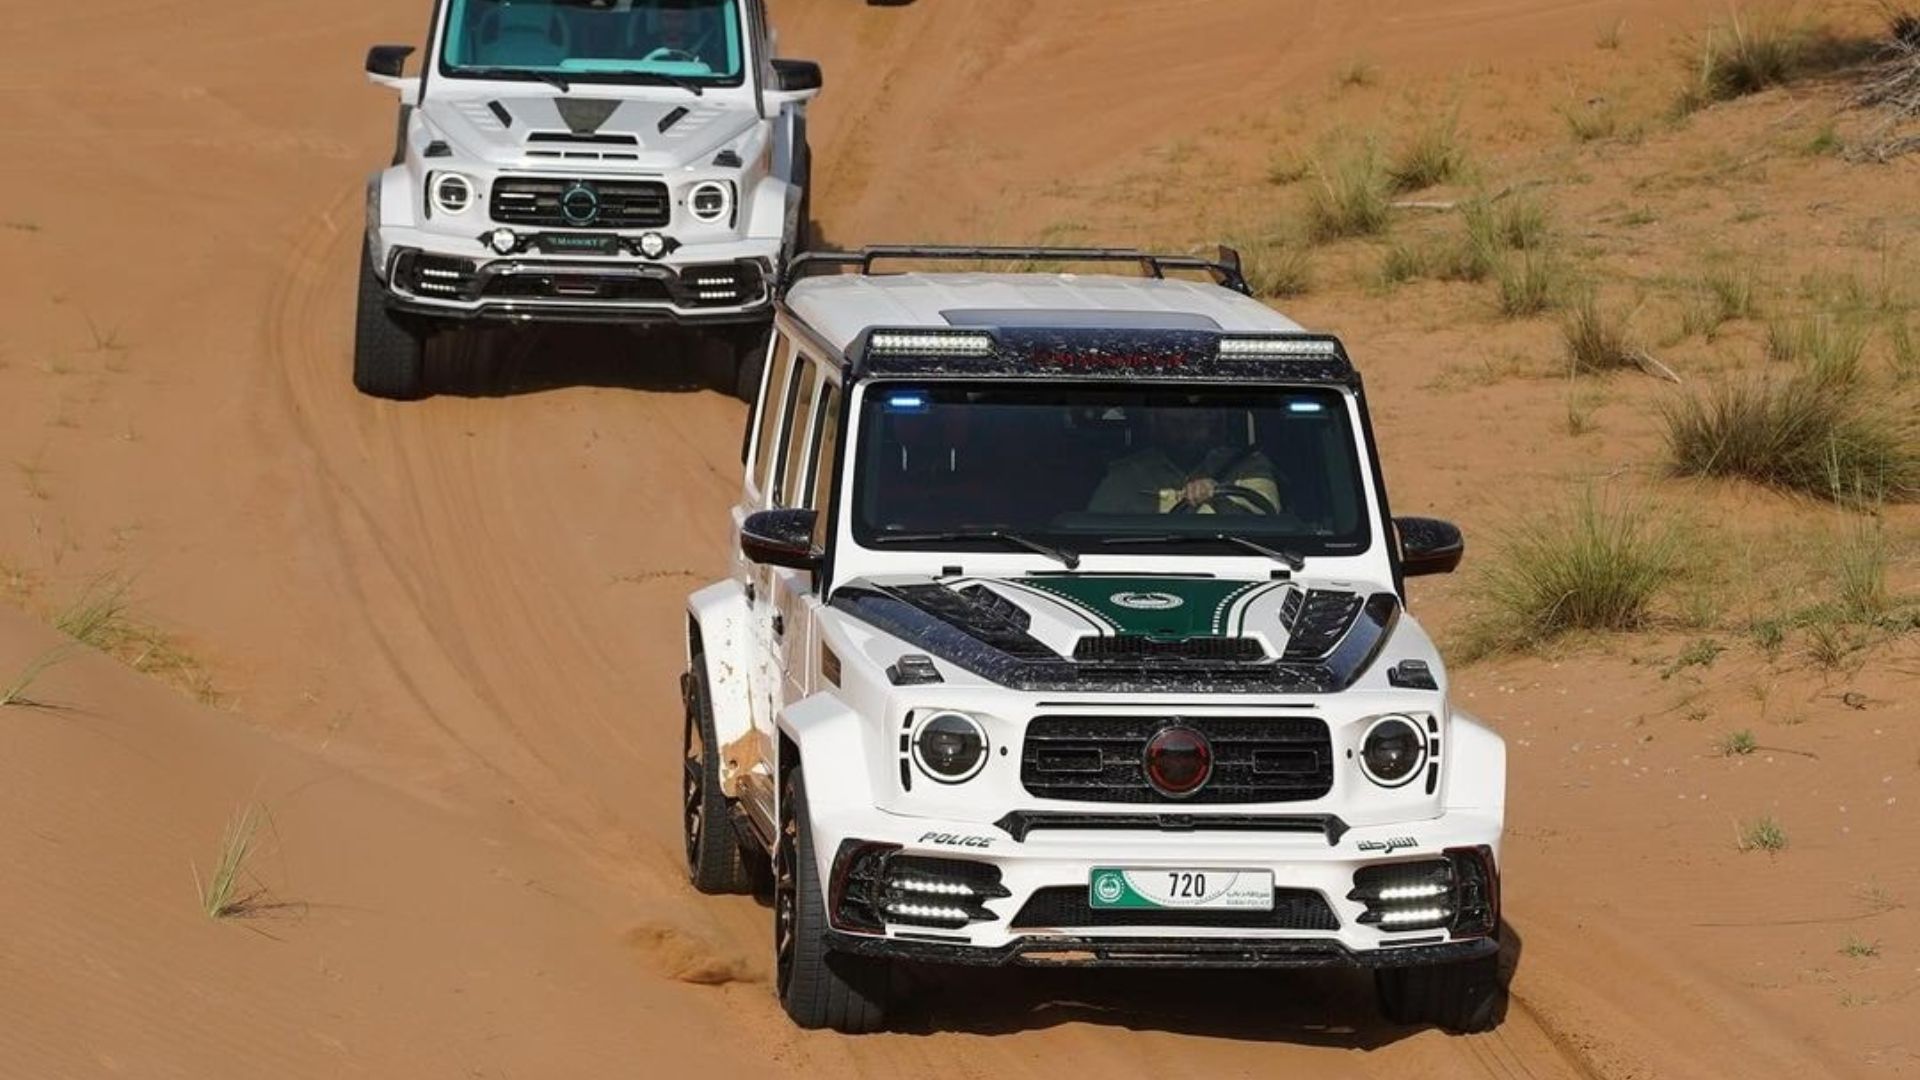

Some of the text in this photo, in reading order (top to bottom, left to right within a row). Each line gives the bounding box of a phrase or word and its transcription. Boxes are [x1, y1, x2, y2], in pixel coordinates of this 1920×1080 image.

[917, 831, 997, 848] POLICE
[1357, 836, 1419, 854] الشرطة
[1168, 872, 1206, 898] 720
